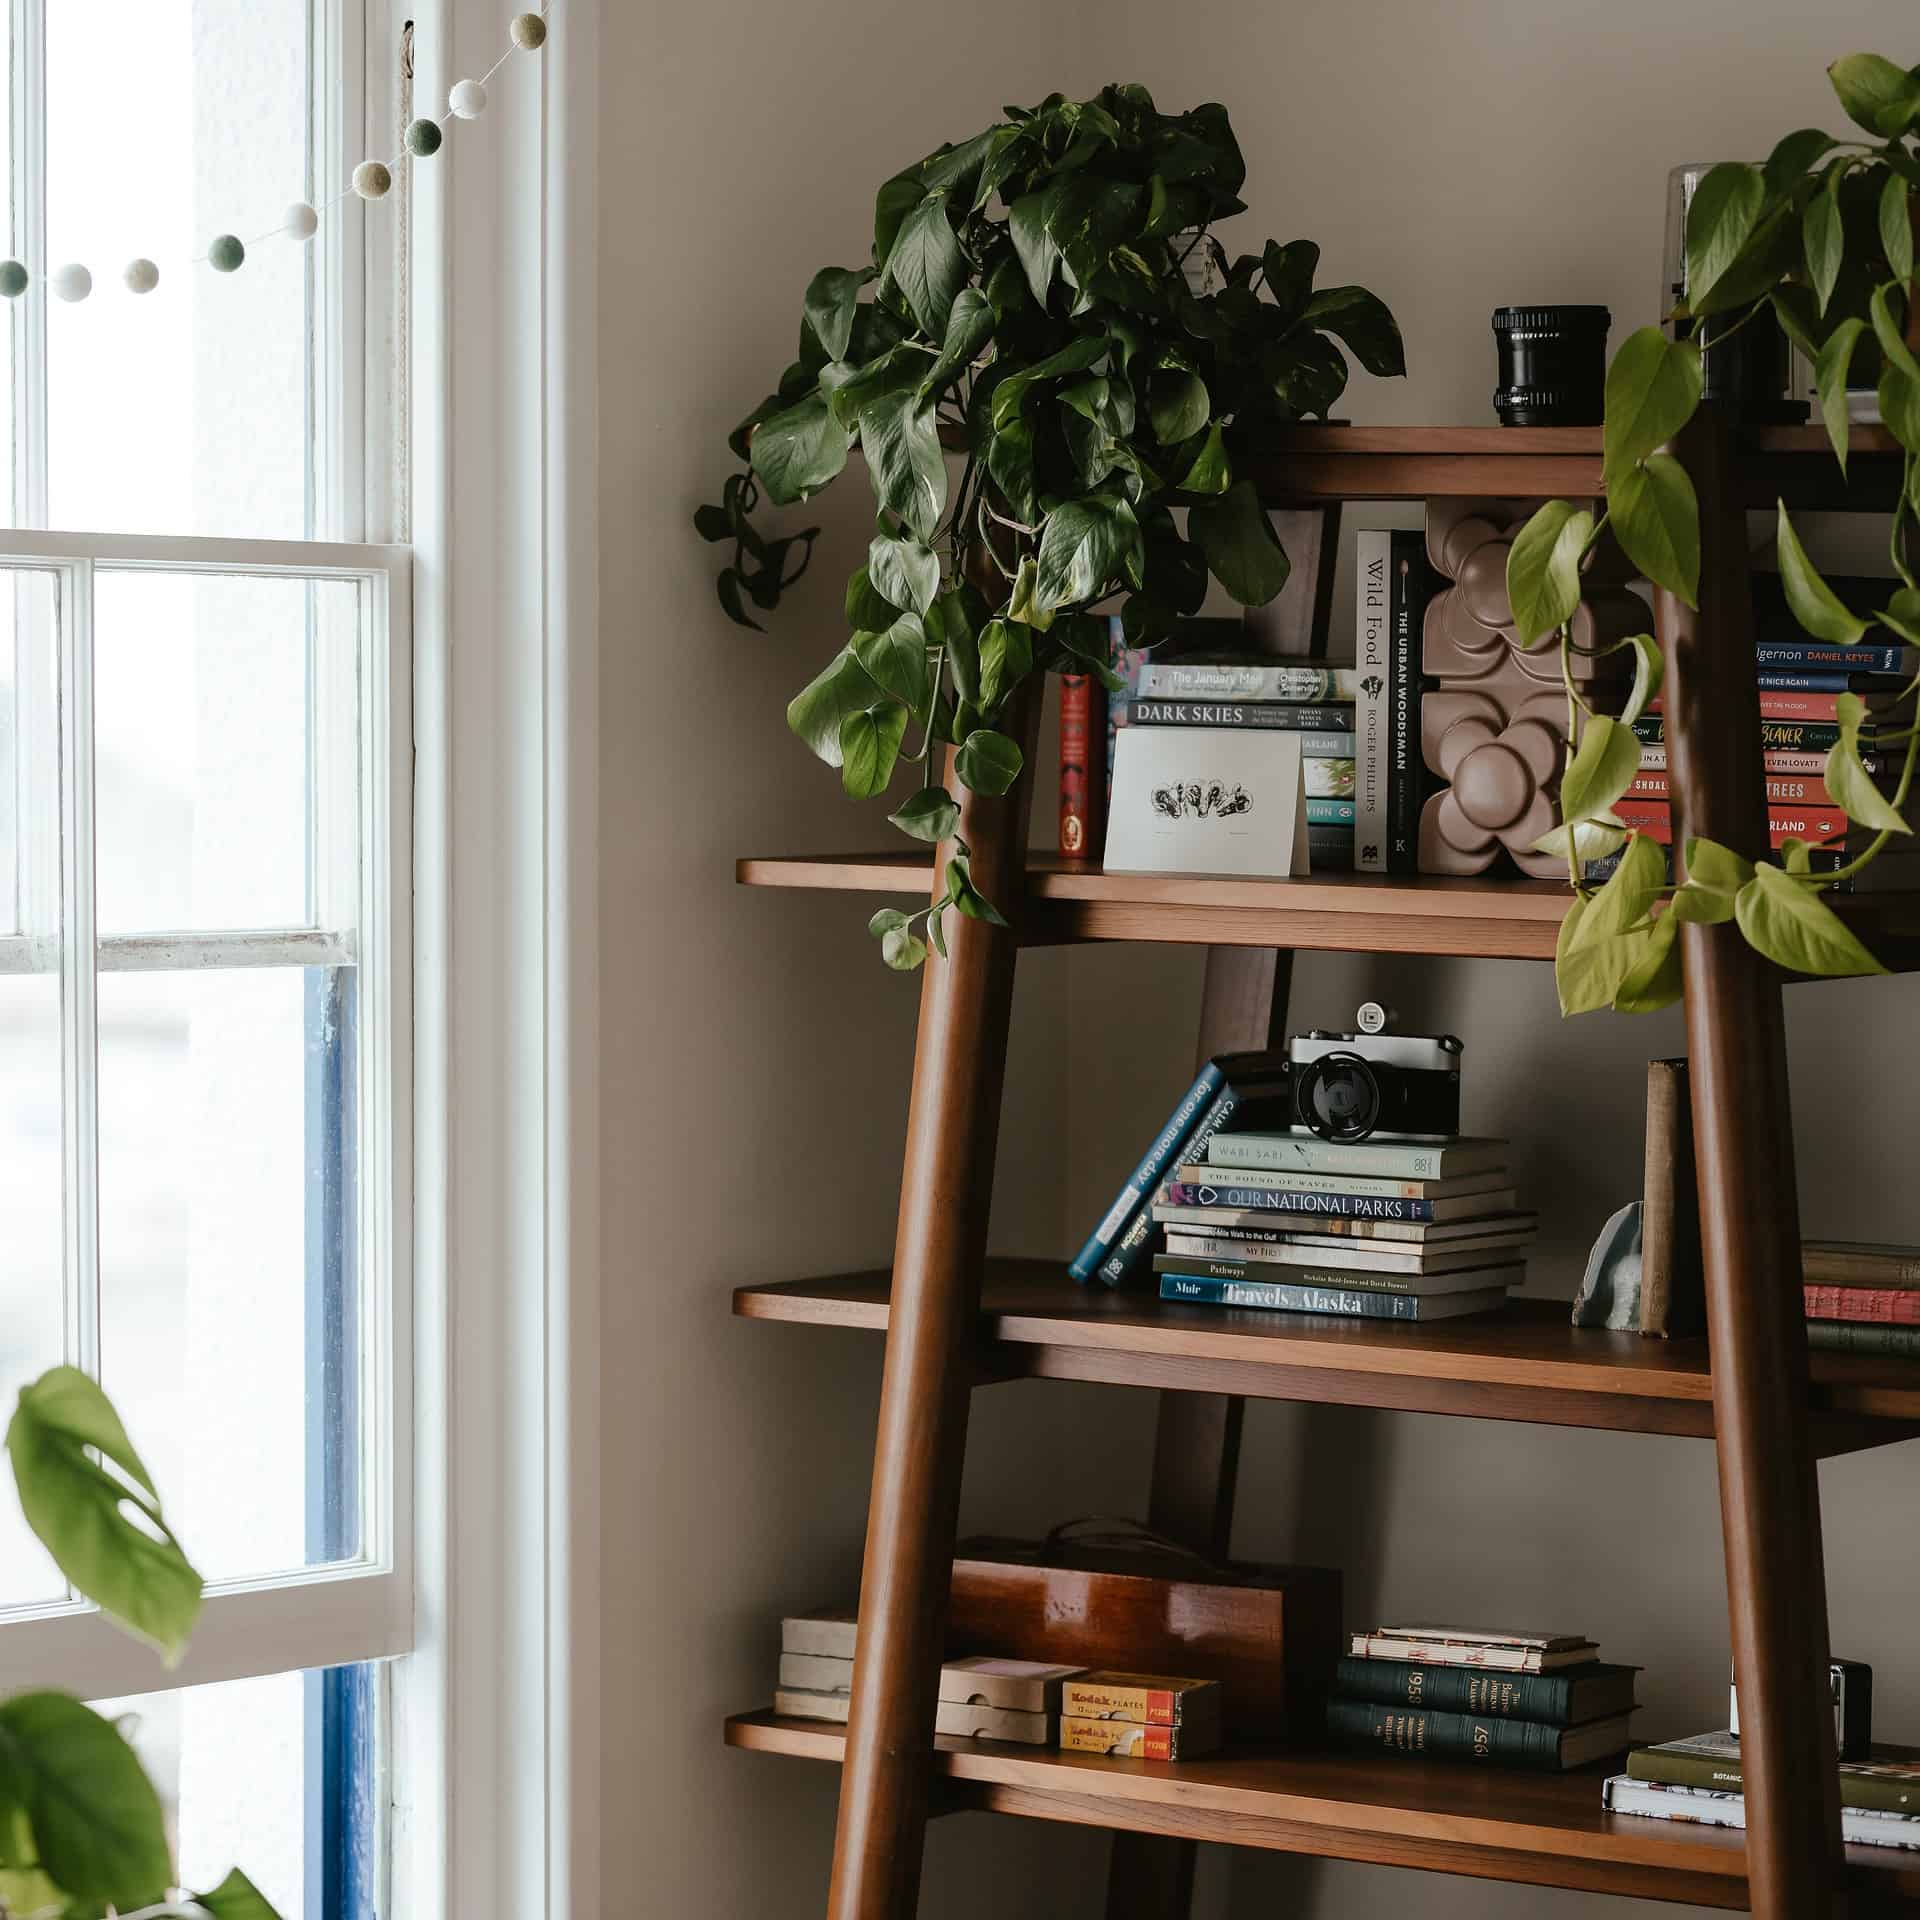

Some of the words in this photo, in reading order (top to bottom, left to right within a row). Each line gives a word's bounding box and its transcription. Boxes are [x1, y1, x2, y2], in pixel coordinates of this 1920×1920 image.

[1367, 558, 1383, 607] Wild
[1399, 612, 1408, 634] THE
[1366, 617, 1383, 665] Food
[1398, 638, 1408, 685] URBAN
[1756, 648, 1802, 662] lgernon
[1808, 652, 1841, 663] DANIEL
[1845, 652, 1873, 663] KEYES
[1172, 671, 1192, 684] The
[1195, 671, 1235, 687] January
[1767, 678, 1784, 687] NICE
[1785, 679, 1809, 687] AGAIN
[1137, 704, 1187, 722] DARK
[1192, 706, 1244, 724] SKIES
[1367, 709, 1377, 752] ROGER
[1397, 688, 1407, 770] WOODSMAN
[1761, 725, 1804, 744] BEAVER
[1302, 739, 1340, 750] ARLANE
[1767, 759, 1788, 767] EVEN
[1367, 757, 1377, 813] PHILLIPS
[1635, 780, 1666, 791] SHOAL
[1766, 783, 1805, 798] TREES
[1769, 821, 1807, 832] RLAND
[1194, 1080, 1212, 1103] for
[1175, 1101, 1195, 1127] one
[1212, 1100, 1234, 1128] CALM
[1153, 1127, 1179, 1161] more
[1219, 1144, 1249, 1158] WABI
[1256, 1150, 1283, 1161] SABI
[1137, 1160, 1156, 1184] day
[1208, 1173, 1231, 1182] THE
[1235, 1175, 1274, 1185] SOUND
[1279, 1177, 1293, 1186] OF
[1297, 1179, 1336, 1189] WAVES
[1227, 1189, 1262, 1207] OUR
[1266, 1192, 1350, 1214] NATIONAL
[1354, 1199, 1403, 1218] PARKS
[1231, 1230, 1245, 1239] Walk
[1246, 1231, 1252, 1239] to
[1253, 1232, 1262, 1240] the
[1264, 1232, 1277, 1241] Gulf
[1210, 1263, 1245, 1278] Pathways
[1176, 1281, 1201, 1295] Muir
[1370, 1280, 1386, 1288] David
[1223, 1283, 1288, 1306] Travels
[1302, 1290, 1362, 1313] Alaska
[1408, 1671, 1424, 1704] 1958
[1071, 1692, 1110, 1706] Kodak
[1113, 1699, 1144, 1710] PLATES
[1474, 1725, 1489, 1757] 1957
[1712, 1771, 1744, 1783] BOTANIC
